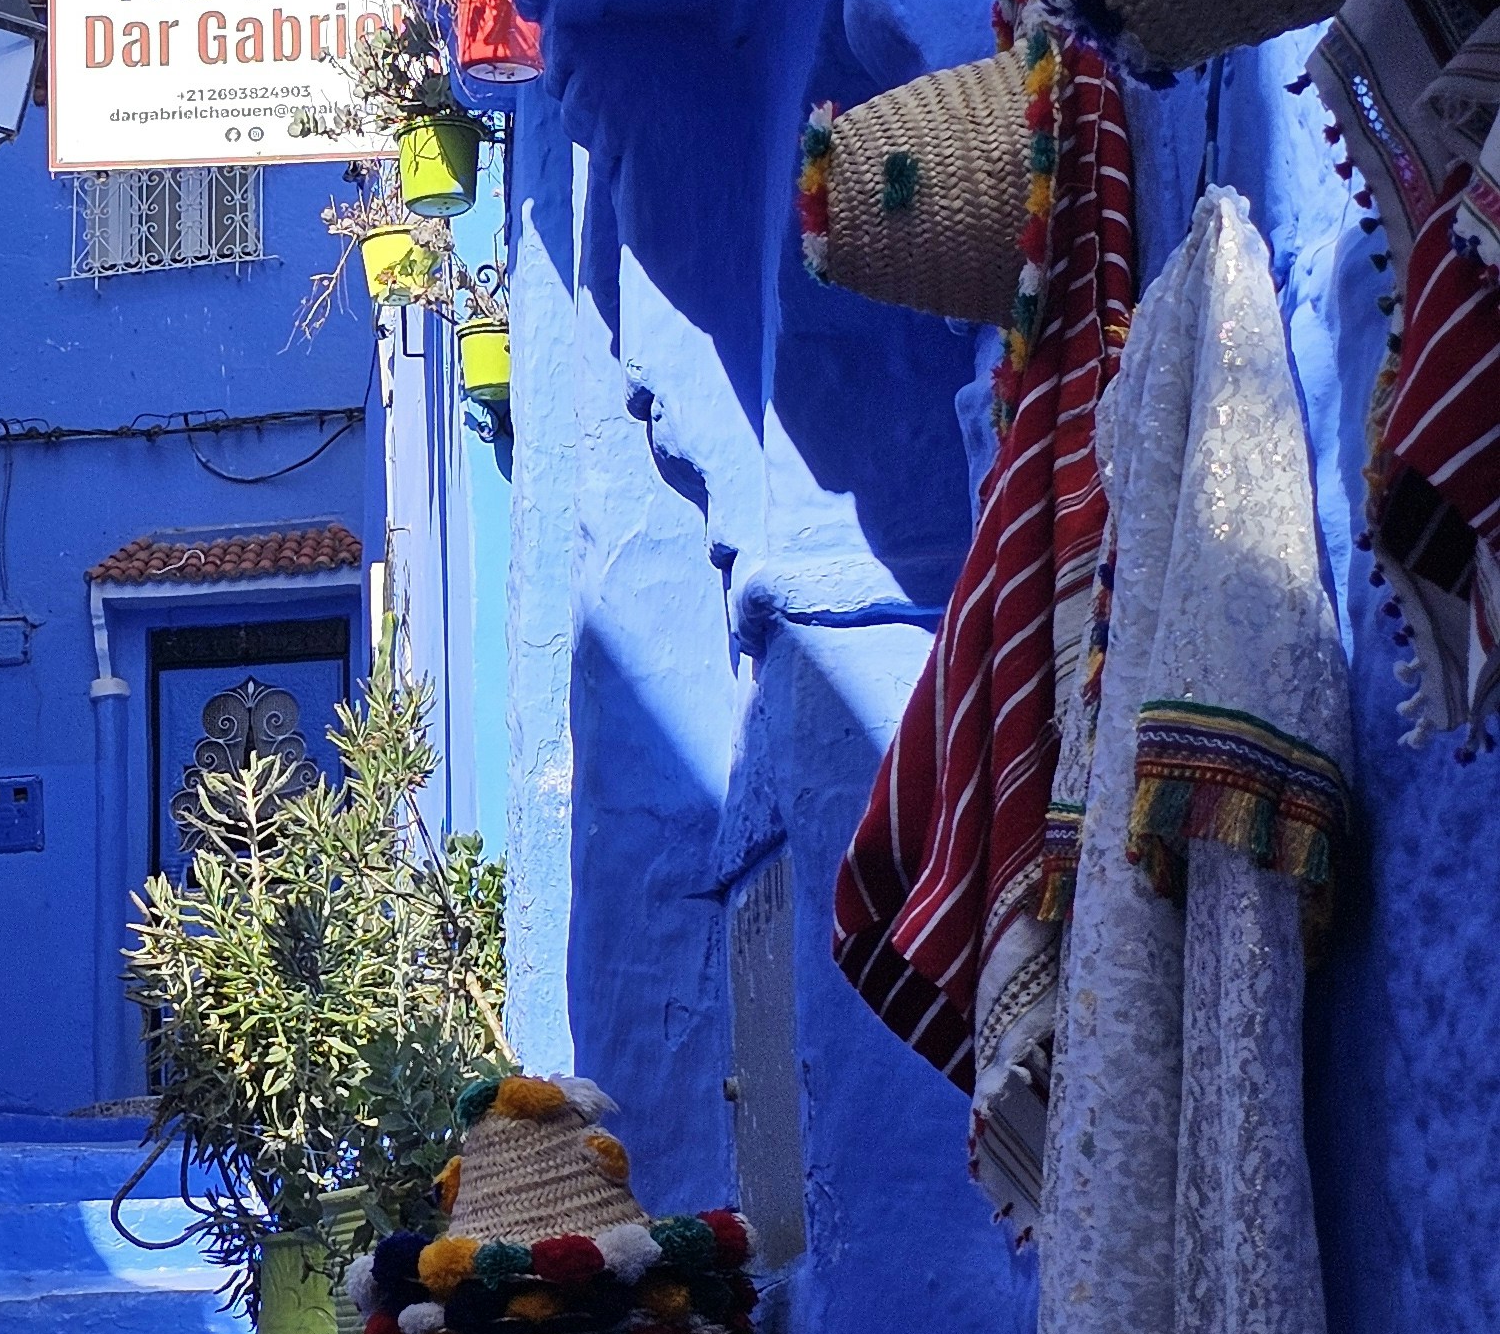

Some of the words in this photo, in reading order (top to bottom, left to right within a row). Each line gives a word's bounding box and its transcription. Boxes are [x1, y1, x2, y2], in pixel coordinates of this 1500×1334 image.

[84, 15, 180, 69] Dar
[177, 85, 312, 102] +212693824903
[109, 100, 379, 125] dargabrielchaouen@gmailo
